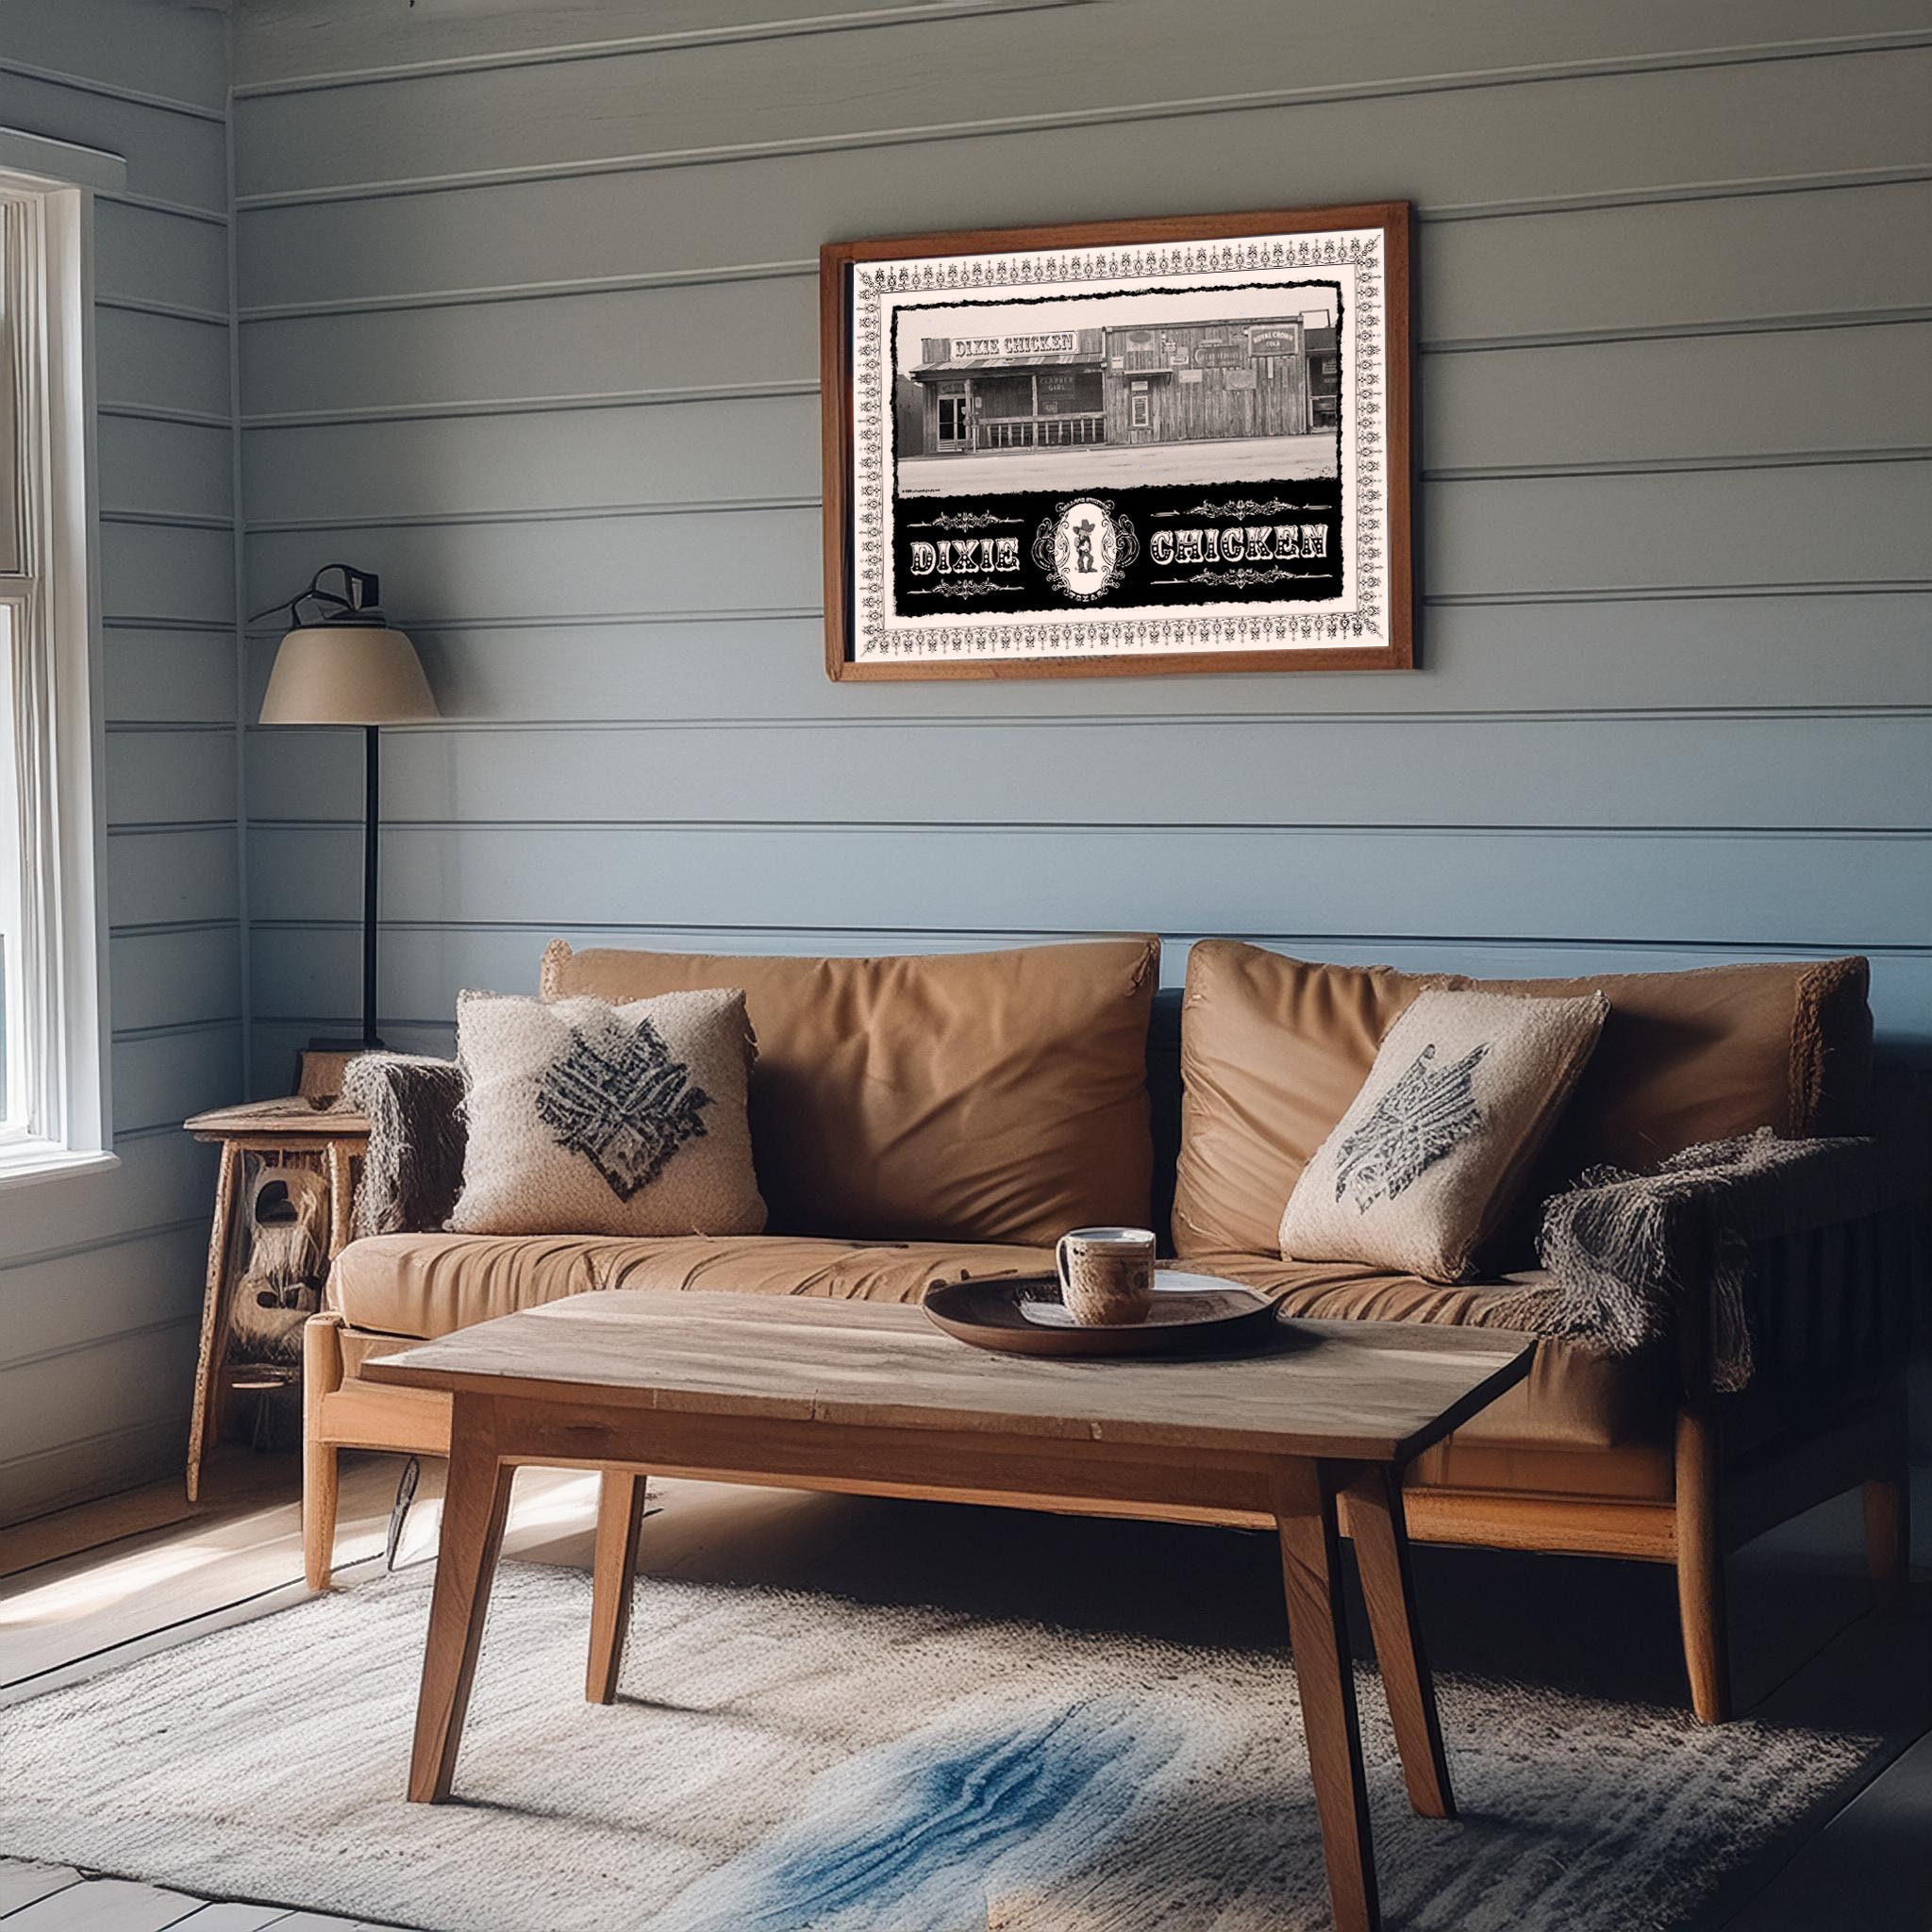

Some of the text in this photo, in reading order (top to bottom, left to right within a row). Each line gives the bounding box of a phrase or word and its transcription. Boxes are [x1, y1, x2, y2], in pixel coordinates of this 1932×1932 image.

[956, 333, 1074, 358] DIXIE CHICKEN
[910, 524, 1329, 575] DIXIE CHICKEN
